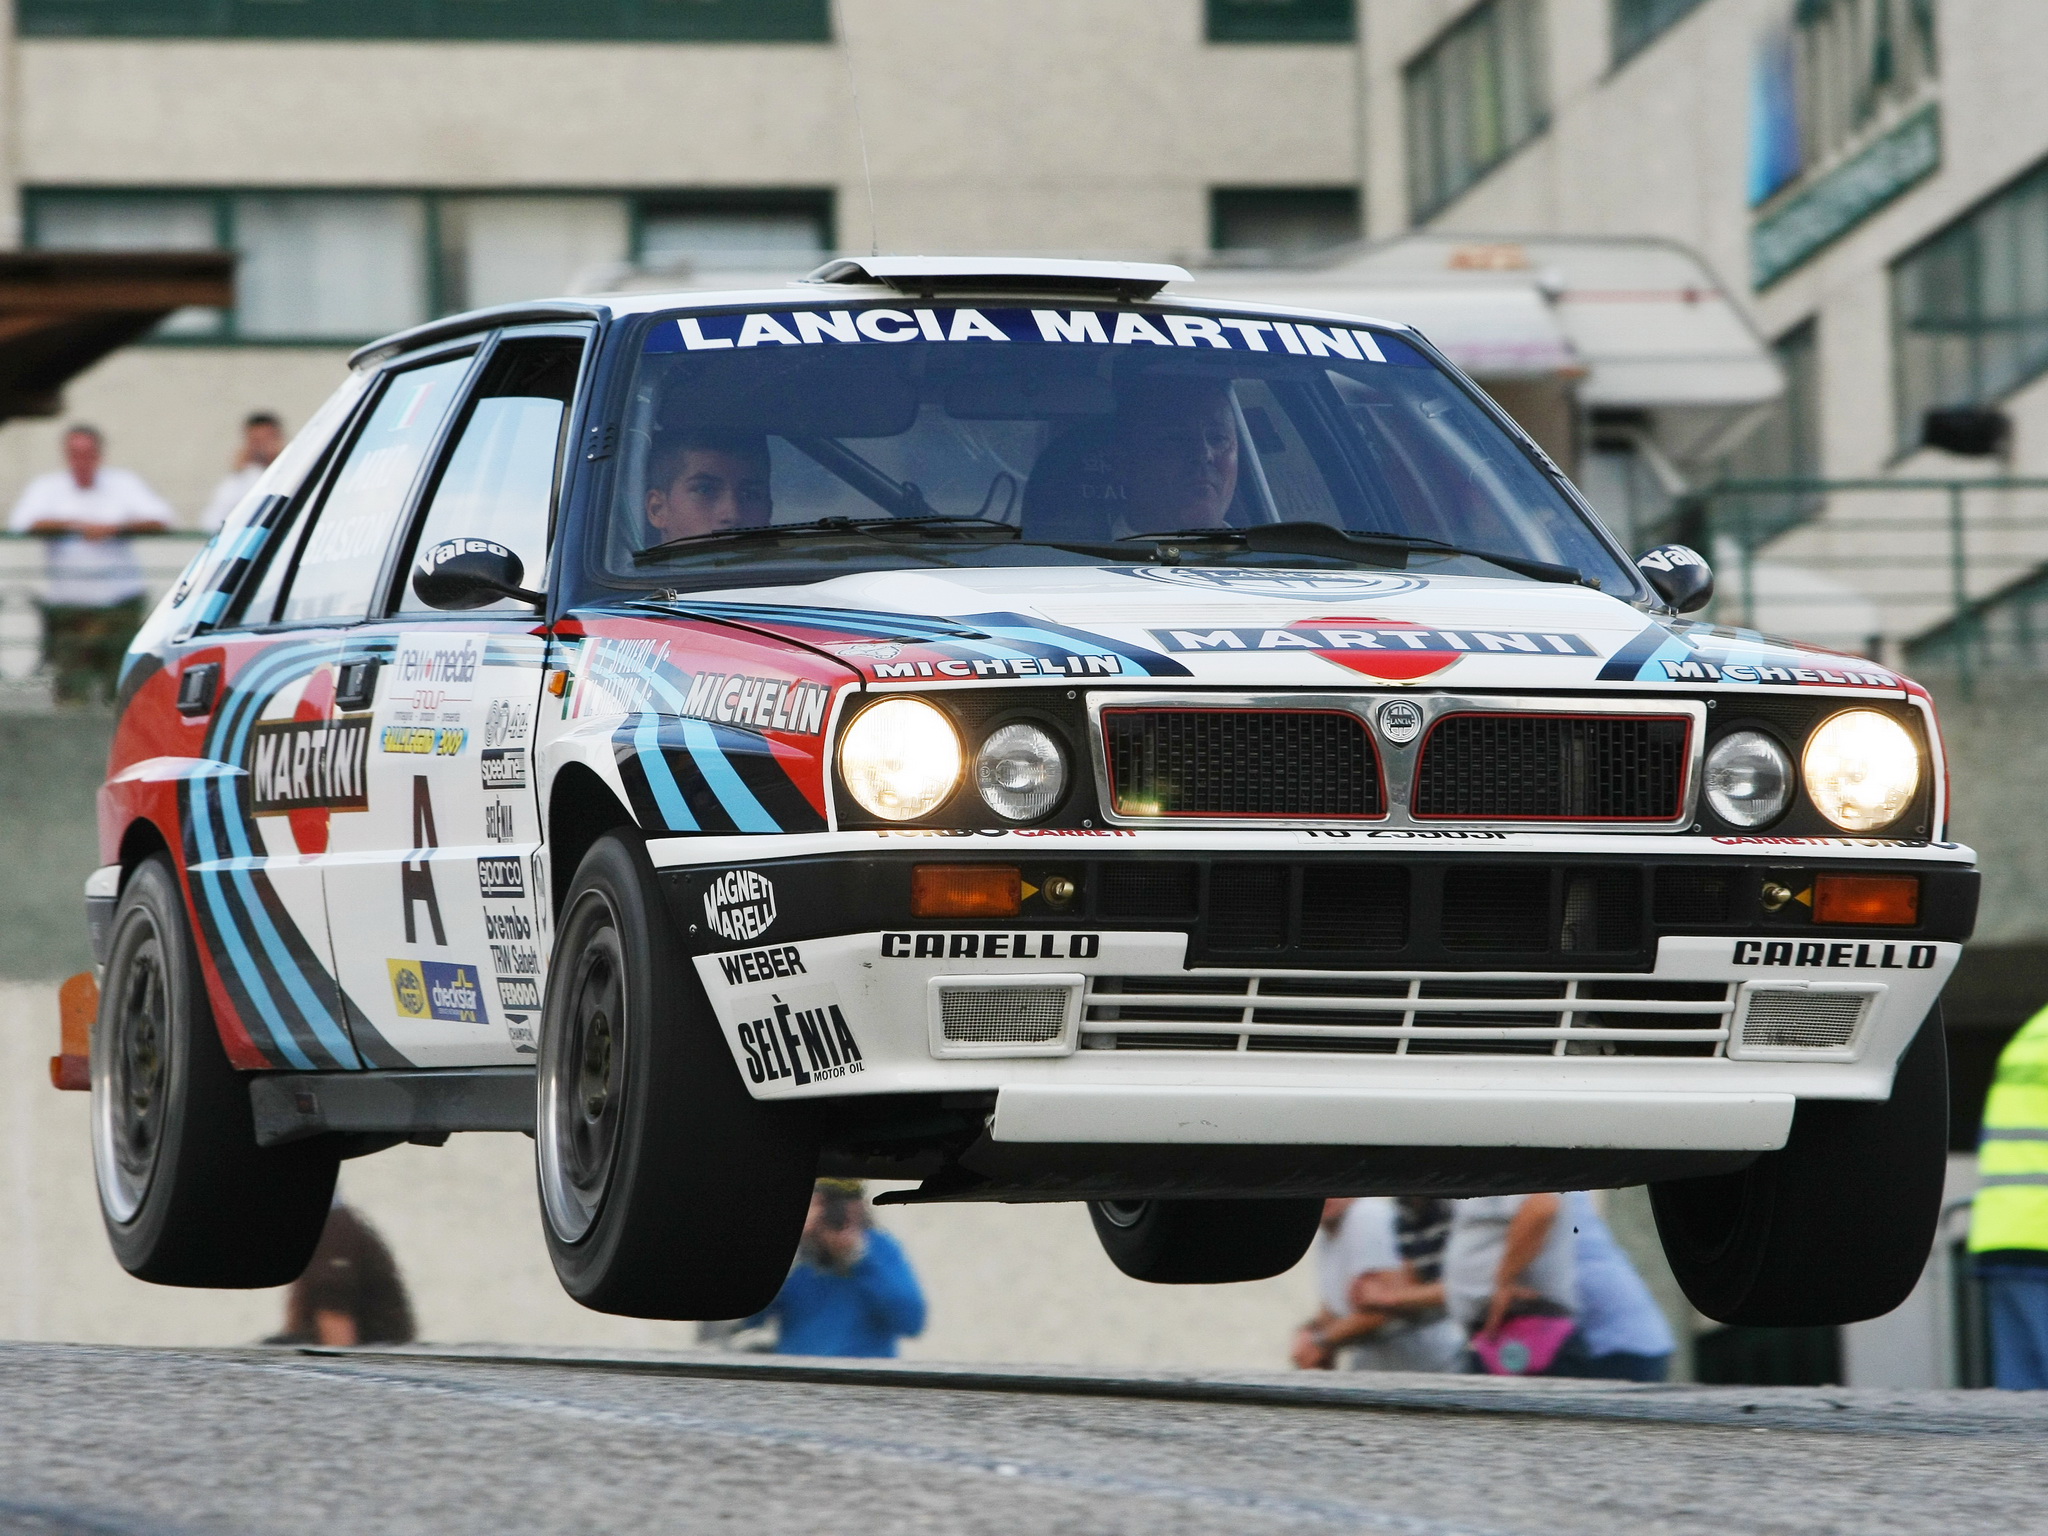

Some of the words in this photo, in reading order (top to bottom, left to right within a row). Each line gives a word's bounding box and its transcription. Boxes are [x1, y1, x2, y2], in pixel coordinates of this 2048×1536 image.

[676, 308, 1012, 351] LANCIA
[1030, 309, 1388, 363] MARTINI
[418, 538, 509, 576] Valeo
[1168, 629, 1578, 655] MARTINI
[873, 653, 1124, 679] MICHELIN
[1659, 659, 1899, 688] MICHELIN
[679, 671, 832, 737] MICHELIN
[255, 726, 366, 803] MARTINI
[401, 774, 449, 947] A
[478, 860, 523, 895] sparco
[703, 870, 777, 909] MAGNETI
[483, 905, 531, 940] brembo
[704, 903, 777, 941] MARELLI
[881, 933, 1100, 959] CARELLO
[1732, 940, 1938, 969] CARELLO
[718, 945, 808, 986] WEBER
[499, 982, 538, 1006] FERODO
[737, 993, 863, 1087] SELÈNIA
[813, 1066, 846, 1083] MOTOR
[849, 1061, 865, 1074] OIL
